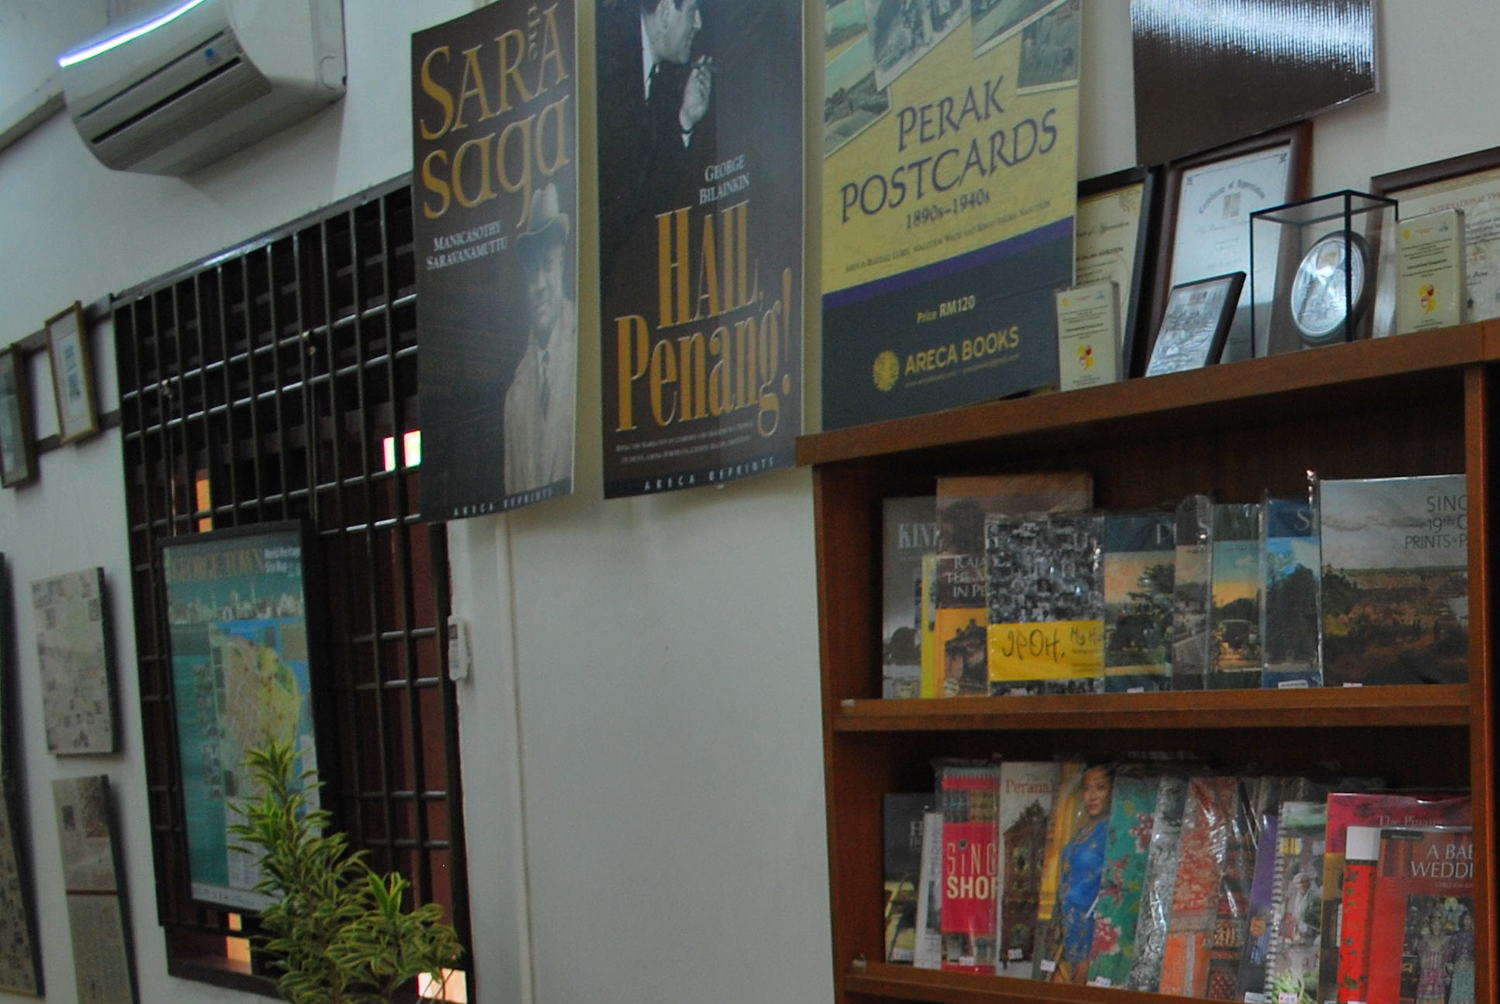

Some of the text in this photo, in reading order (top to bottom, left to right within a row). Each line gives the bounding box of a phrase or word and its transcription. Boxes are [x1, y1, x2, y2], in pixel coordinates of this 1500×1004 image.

[419, 3, 571, 140] SARA
[896, 75, 1005, 152] PERAK
[421, 94, 571, 228] saga
[698, 173, 751, 205] BILAINKIN
[703, 153, 746, 183] GEORGE
[840, 107, 1058, 225] POSTCARDS
[614, 267, 793, 437] Penang!
[903, 343, 958, 377] ARECA
[961, 325, 1020, 362] BOOKS
[1405, 535, 1451, 549] PRINTS
